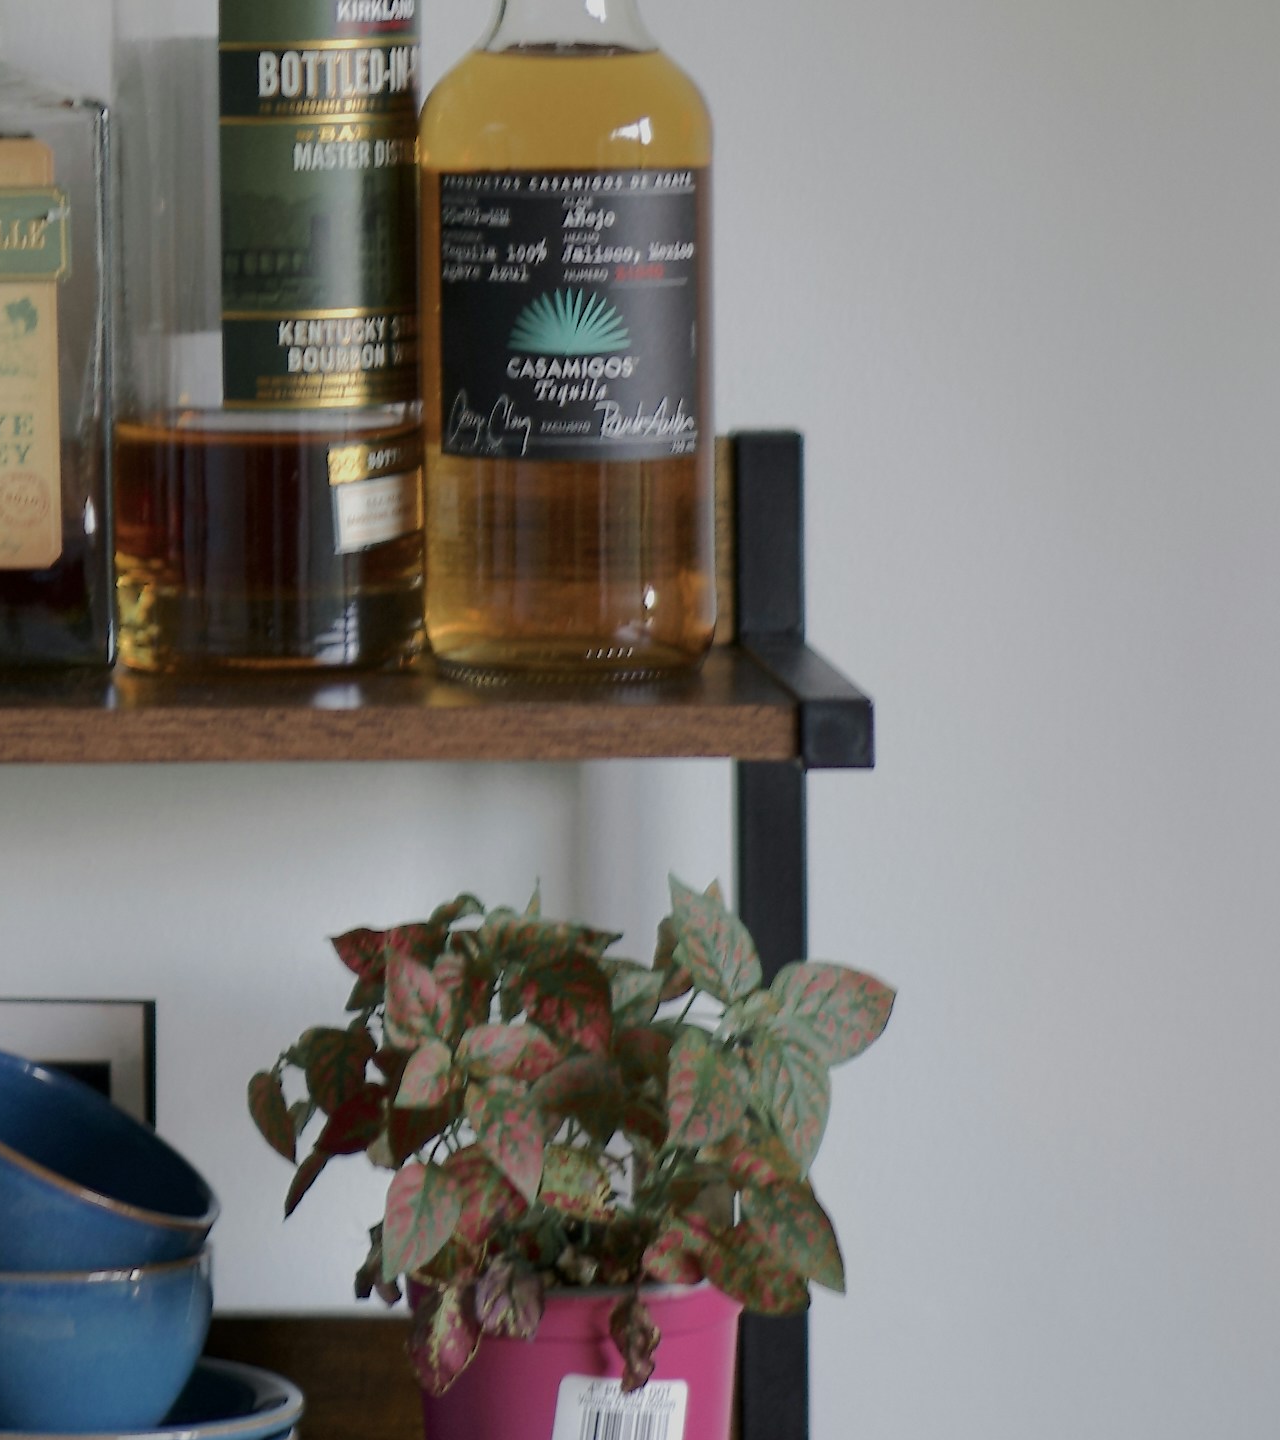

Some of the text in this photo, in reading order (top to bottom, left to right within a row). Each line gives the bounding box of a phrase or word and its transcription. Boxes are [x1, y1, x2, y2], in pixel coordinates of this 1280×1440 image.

[294, 142, 370, 171] MASTER
[528, 176, 623, 191] CASAMIGOS
[630, 175, 648, 190] DE
[562, 206, 616, 231] Añejo
[278, 317, 386, 346] KENTUCKY
[288, 344, 385, 372] BOURBON
[506, 356, 634, 380] CASAMIGOS
[534, 379, 608, 408] Tequila
